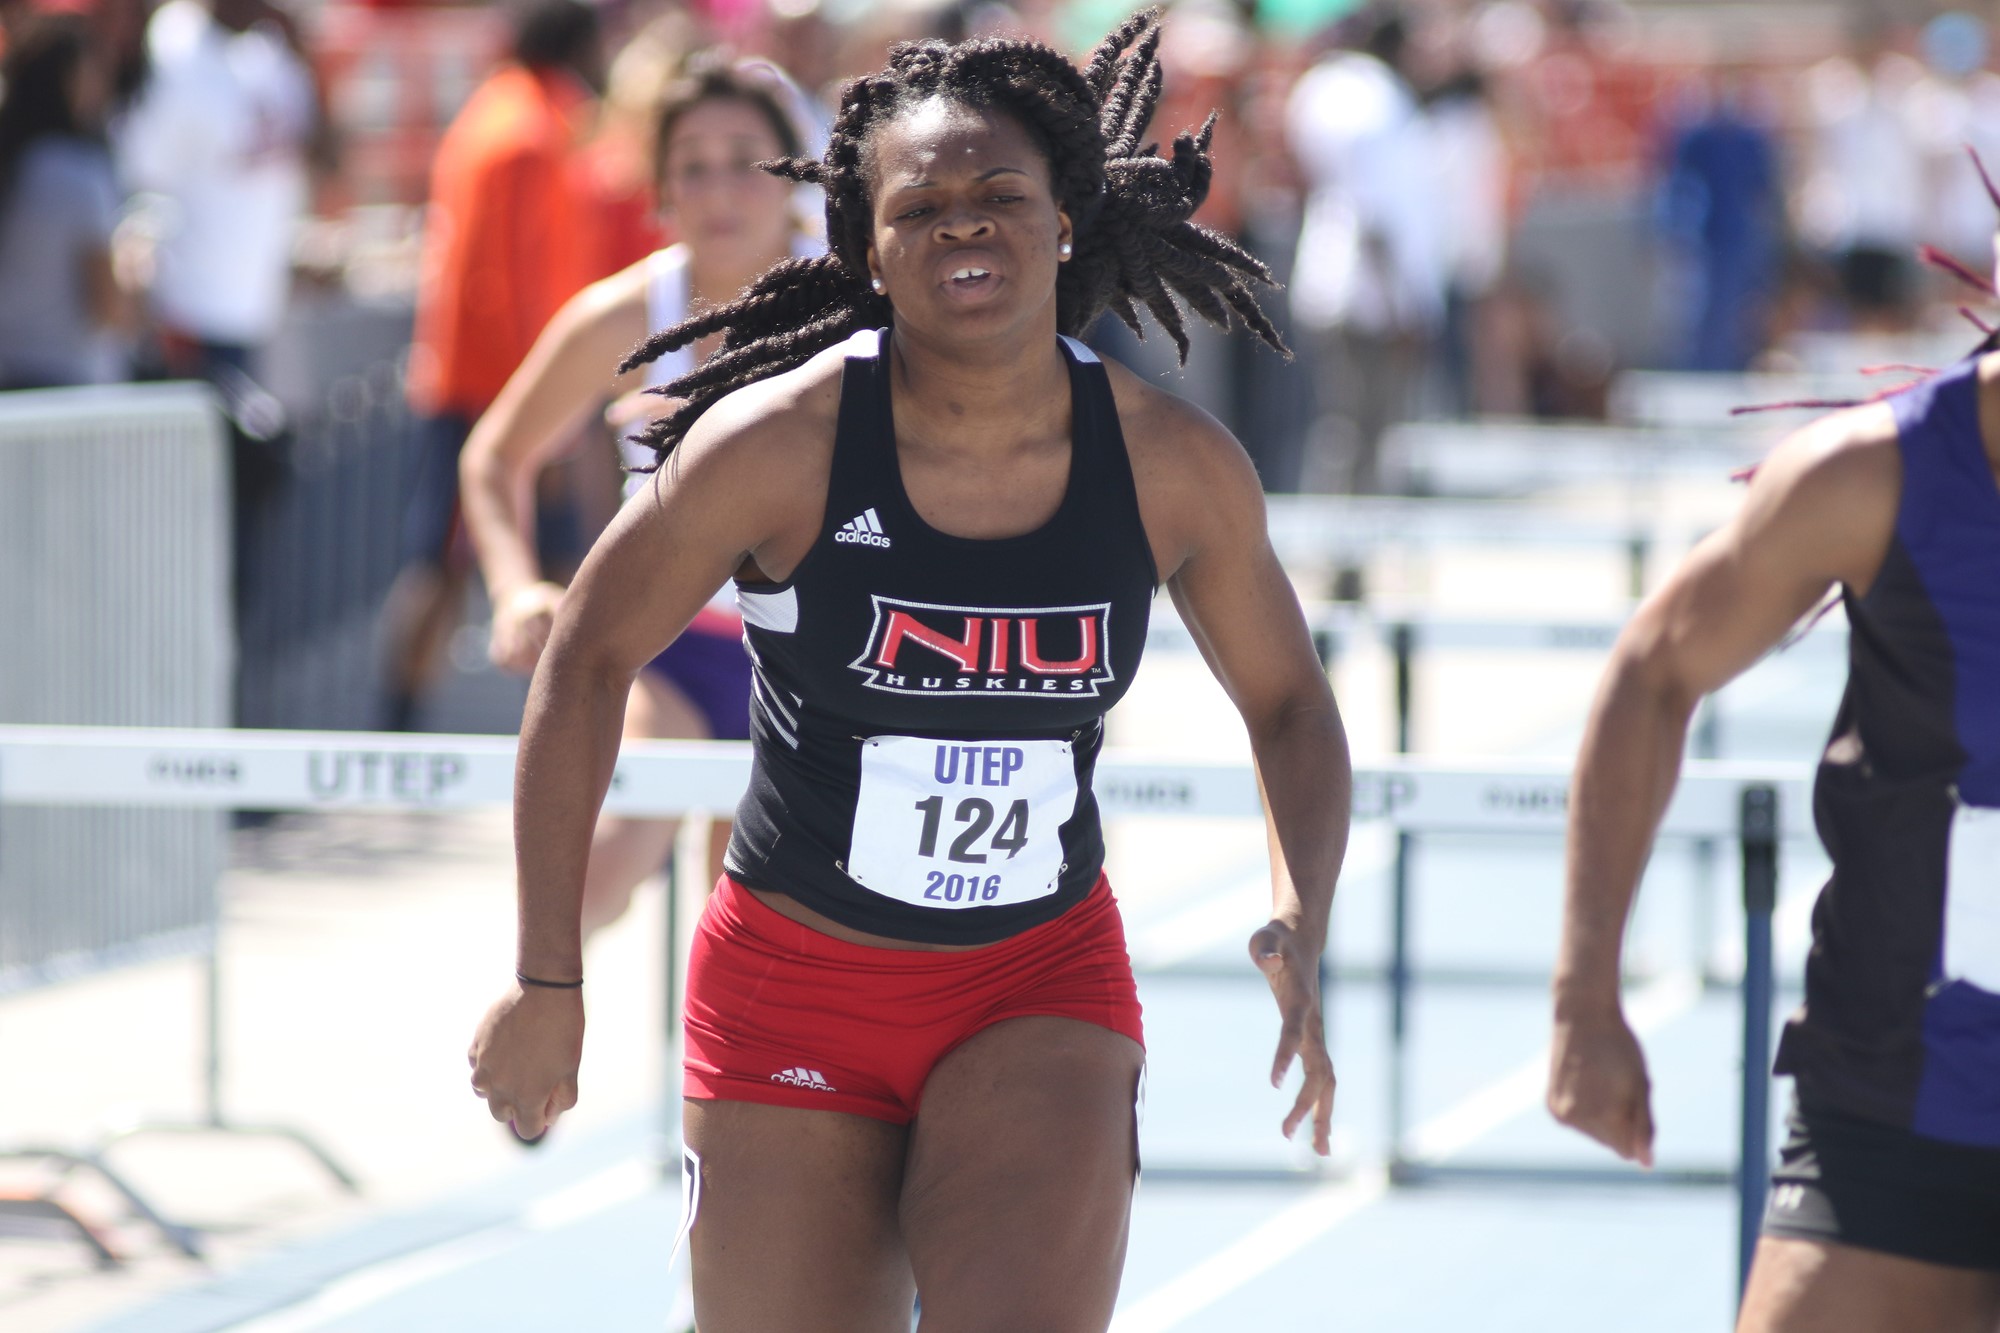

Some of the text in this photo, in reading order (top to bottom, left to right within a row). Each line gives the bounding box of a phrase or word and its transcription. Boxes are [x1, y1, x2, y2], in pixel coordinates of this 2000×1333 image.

[834, 529, 891, 548] adidas
[874, 609, 1097, 674] NIU
[885, 673, 1084, 691] HUSKIES
[307, 750, 469, 800] UTEP
[934, 744, 1024, 787] UTEP
[914, 795, 1030, 864] 124
[923, 870, 1002, 902] 2016
